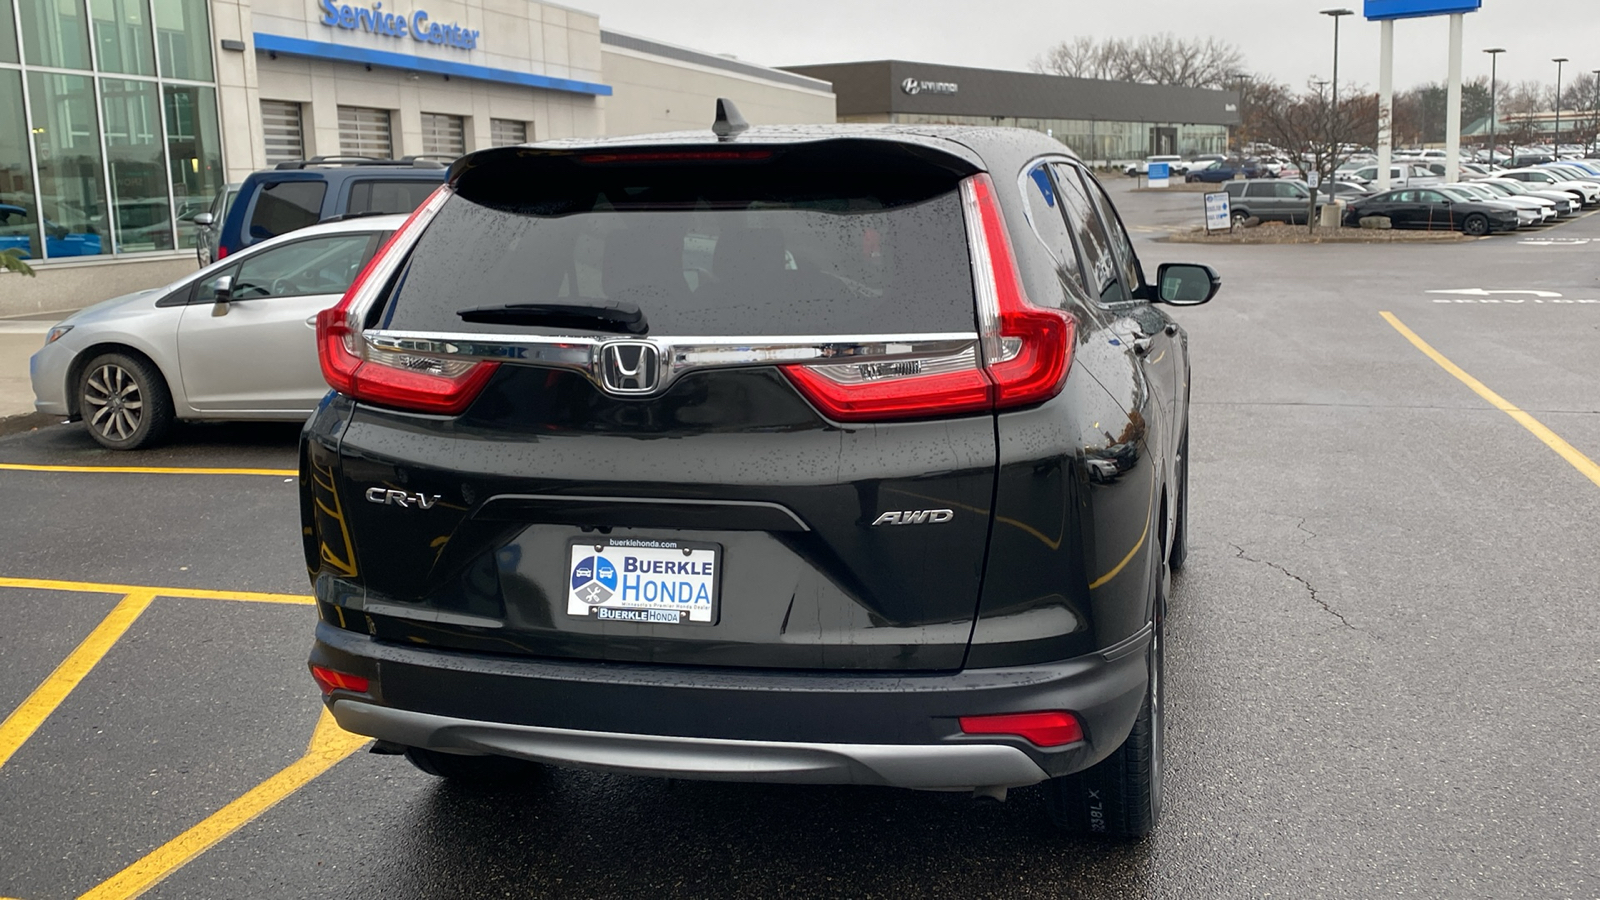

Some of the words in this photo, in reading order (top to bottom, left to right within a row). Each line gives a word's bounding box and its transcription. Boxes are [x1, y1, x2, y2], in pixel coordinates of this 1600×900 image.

[320, 0, 407, 37] Service
[410, 10, 480, 50] Center
[365, 487, 441, 509] CR-V
[872, 508, 954, 525] AWD
[609, 539, 677, 548] buerklehonda.com
[624, 556, 712, 575] BUERKLE
[622, 574, 711, 604] HONDA
